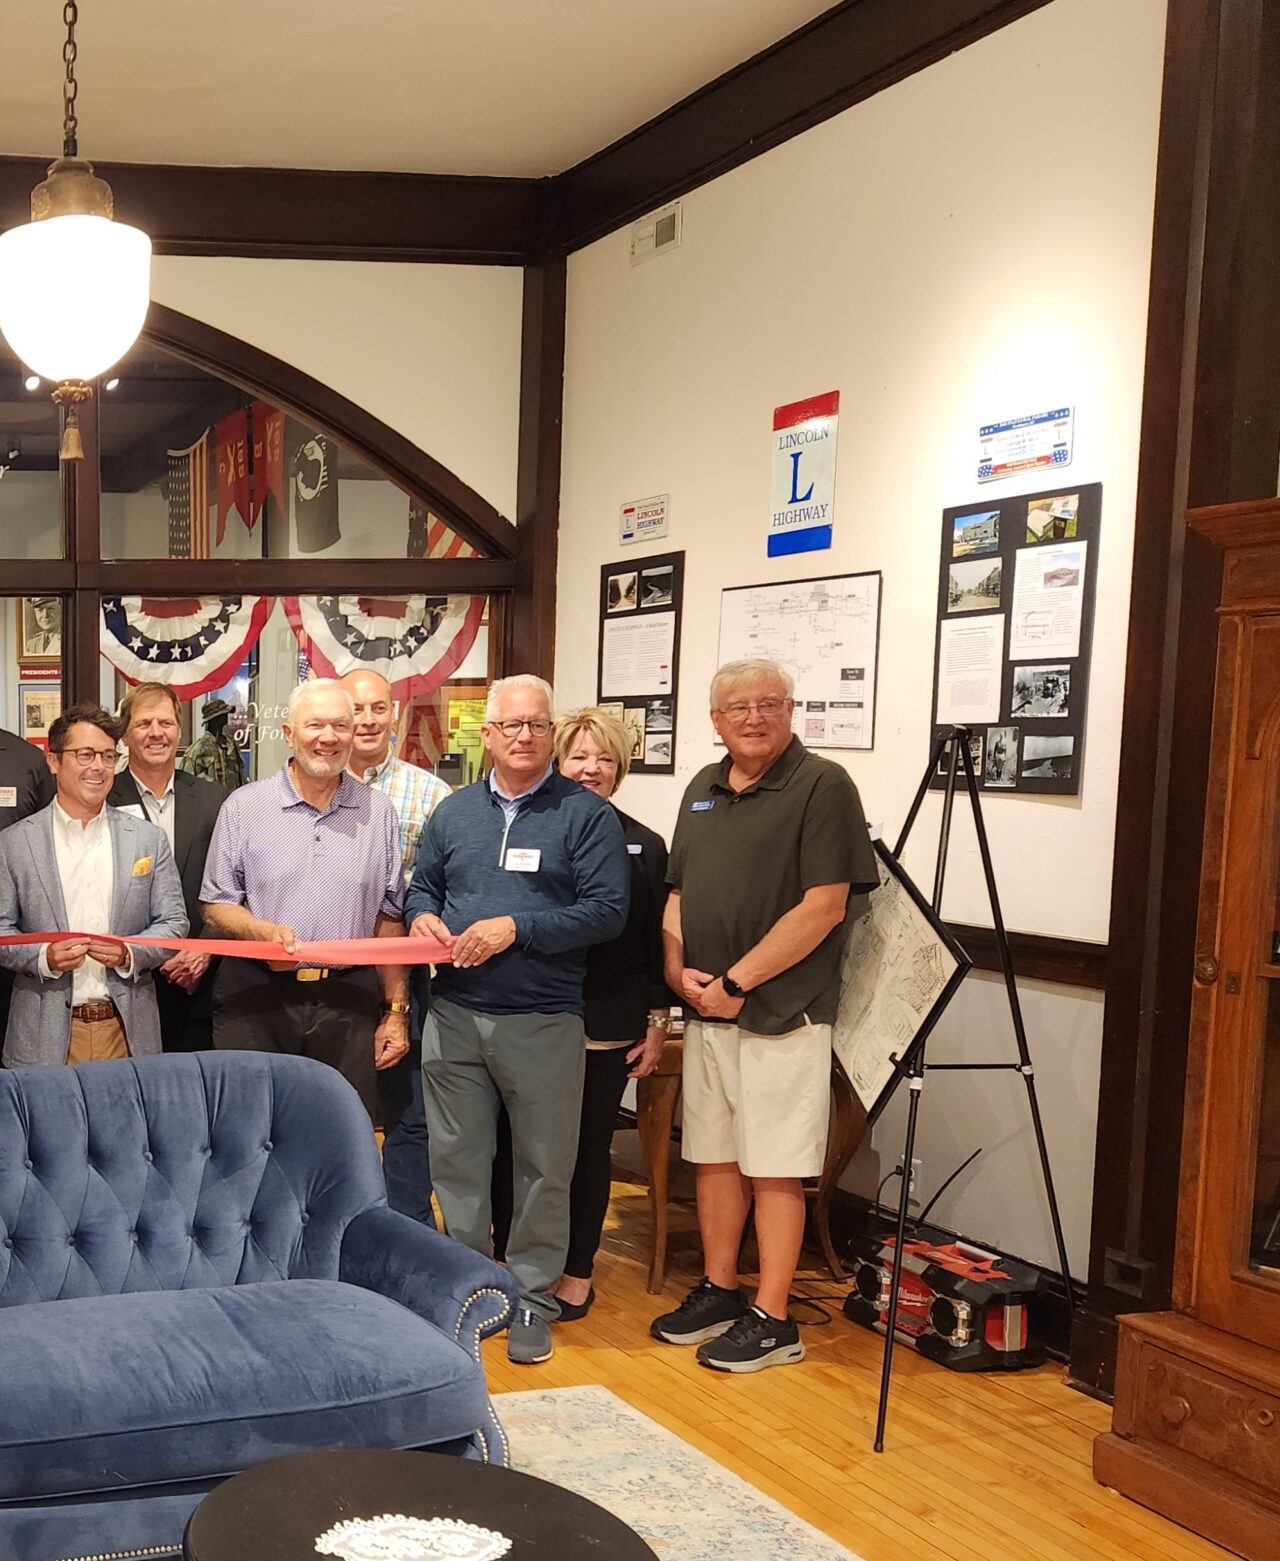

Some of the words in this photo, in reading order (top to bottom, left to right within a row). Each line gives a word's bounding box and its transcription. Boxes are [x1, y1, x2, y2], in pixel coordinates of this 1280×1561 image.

[779, 425, 830, 450] LINCOLN
[788, 451, 814, 504] L
[773, 503, 828, 527] HIGHWAY
[234, 723, 254, 747] of
